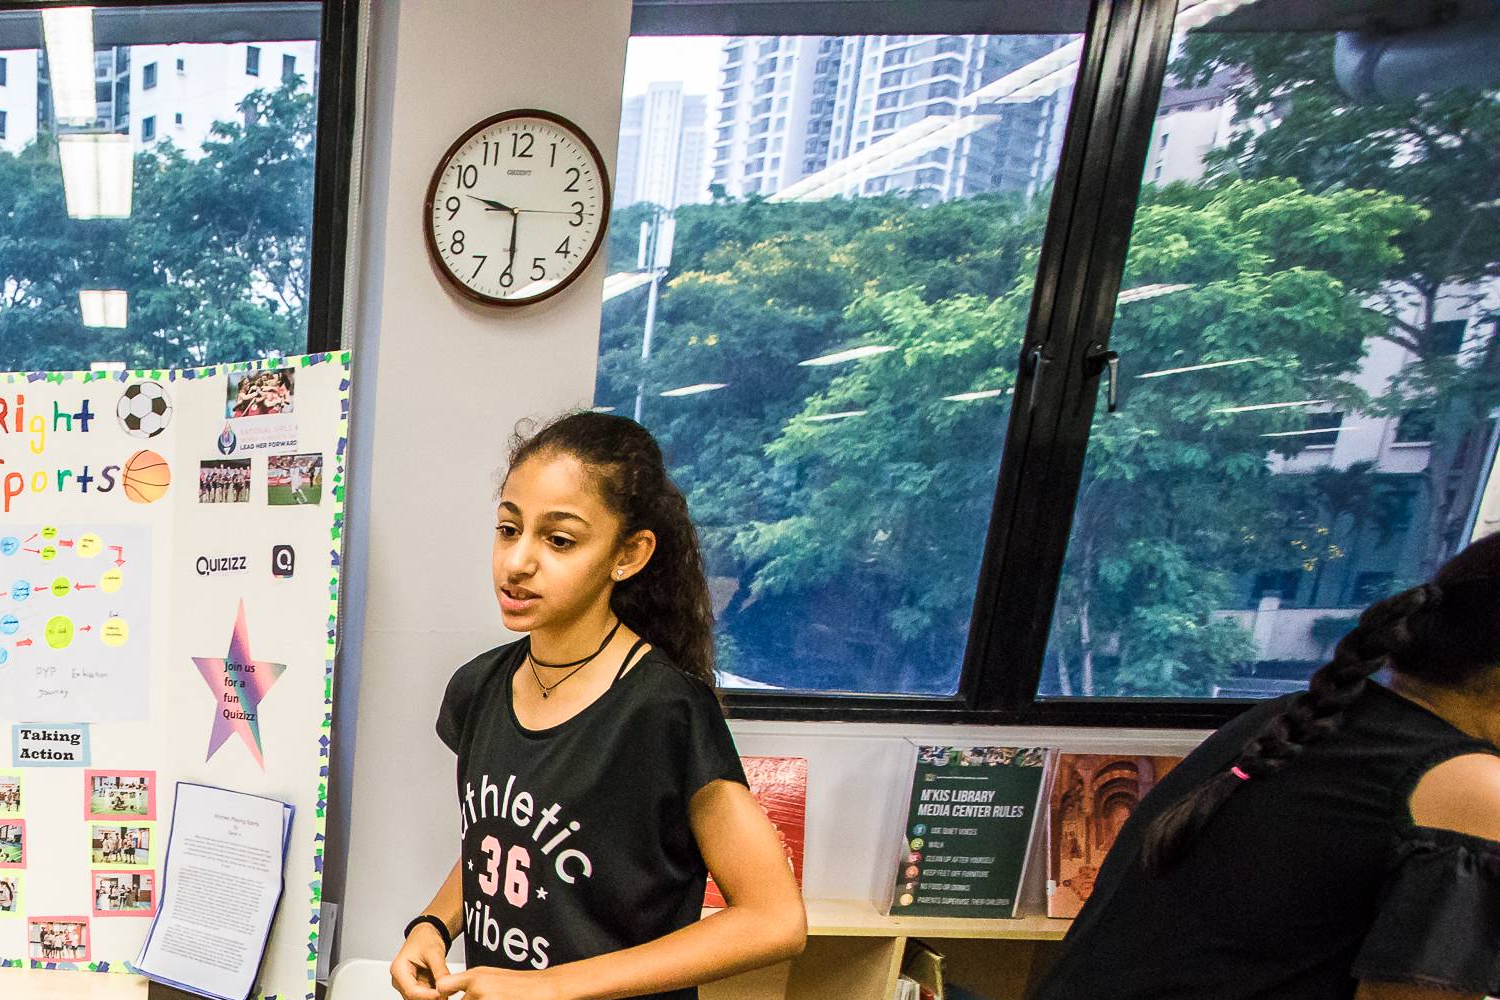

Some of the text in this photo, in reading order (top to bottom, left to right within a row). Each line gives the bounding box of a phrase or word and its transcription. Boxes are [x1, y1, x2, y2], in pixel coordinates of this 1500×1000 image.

[483, 142, 499, 166] 11
[512, 133, 534, 157] 12
[550, 144, 556, 167] 1
[457, 165, 478, 188] 10
[564, 168, 580, 192] 2
[446, 196, 460, 221] 9
[569, 201, 584, 227] 3
[450, 230, 465, 255] 8
[555, 236, 571, 259] 4
[472, 256, 487, 279] 7
[499, 264, 513, 287] 6
[530, 258, 546, 281] 5
[268, 440, 297, 448] FORWARD
[224, 661, 256, 673] Join us
[224, 677, 246, 688] for a
[223, 693, 239, 703] fun
[223, 709, 256, 721] Quizizz
[20, 729, 81, 745] Taking
[20, 748, 74, 760] Action
[920, 789, 996, 802] M'KIS LIBRARY
[918, 803, 1025, 818] MEDIA CENTER RULES
[478, 835, 531, 909] 36
[464, 901, 550, 970] vibes
